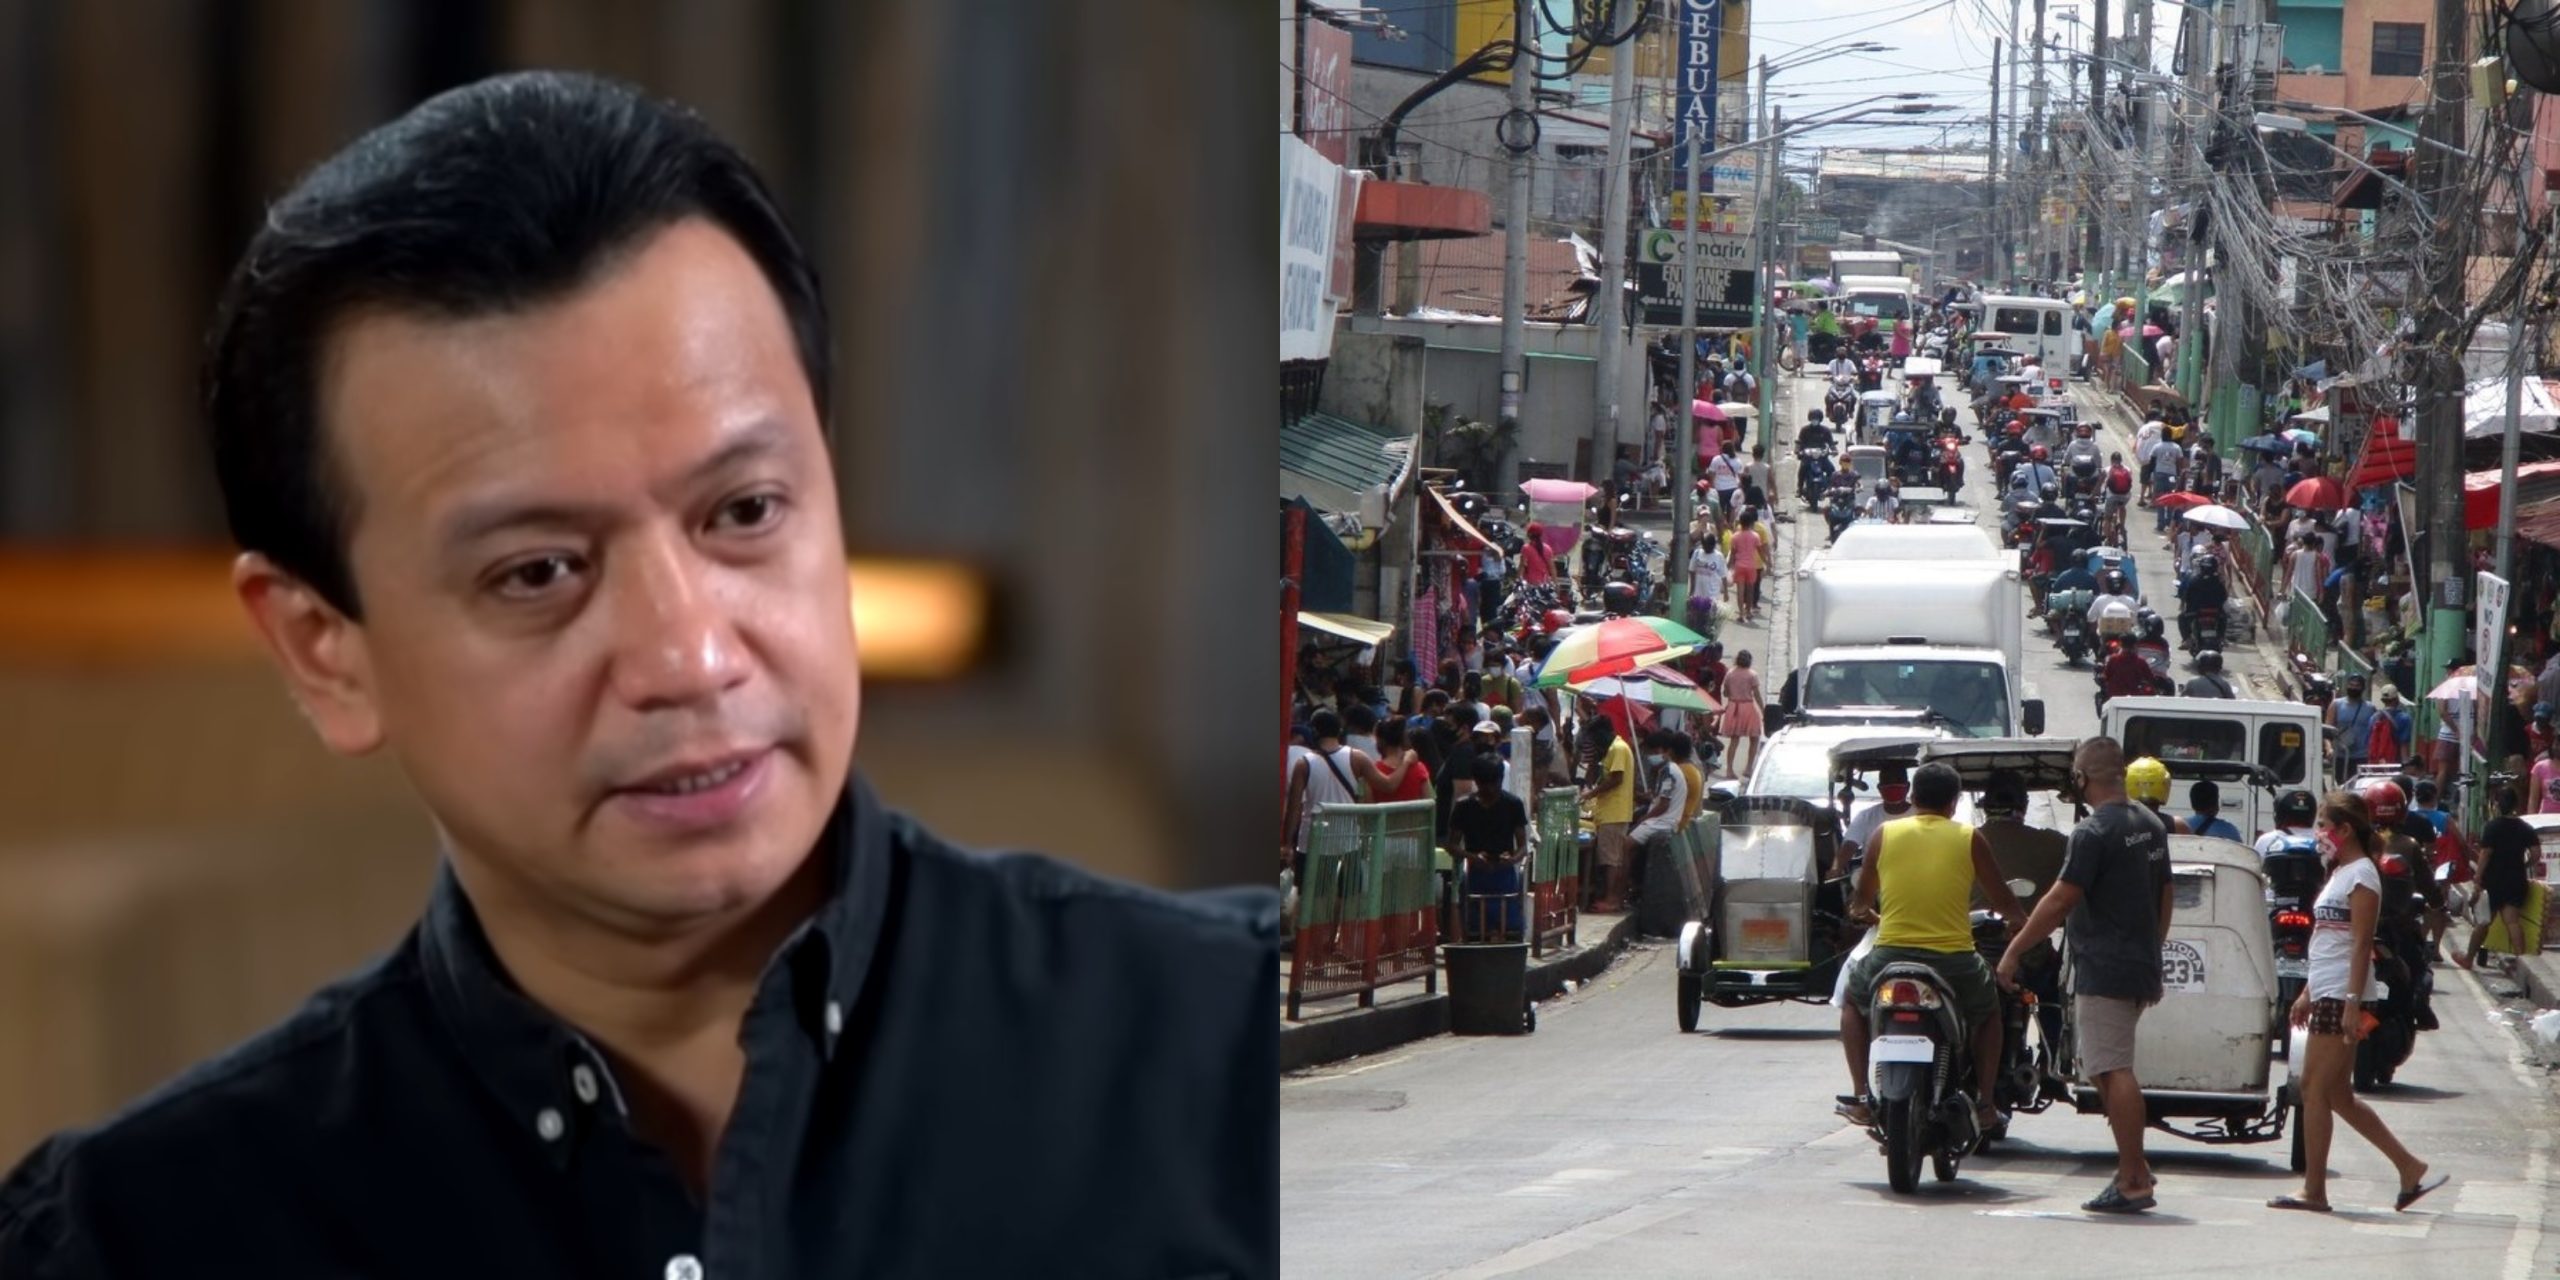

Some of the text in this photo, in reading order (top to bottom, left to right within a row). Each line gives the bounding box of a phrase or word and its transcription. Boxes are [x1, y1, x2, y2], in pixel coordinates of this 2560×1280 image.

[1682, 0, 1716, 167] EBUAN
[1662, 264, 1732, 287] ENTANCE
[1666, 280, 1726, 302] PAKING
[2162, 959, 2190, 984] 23
